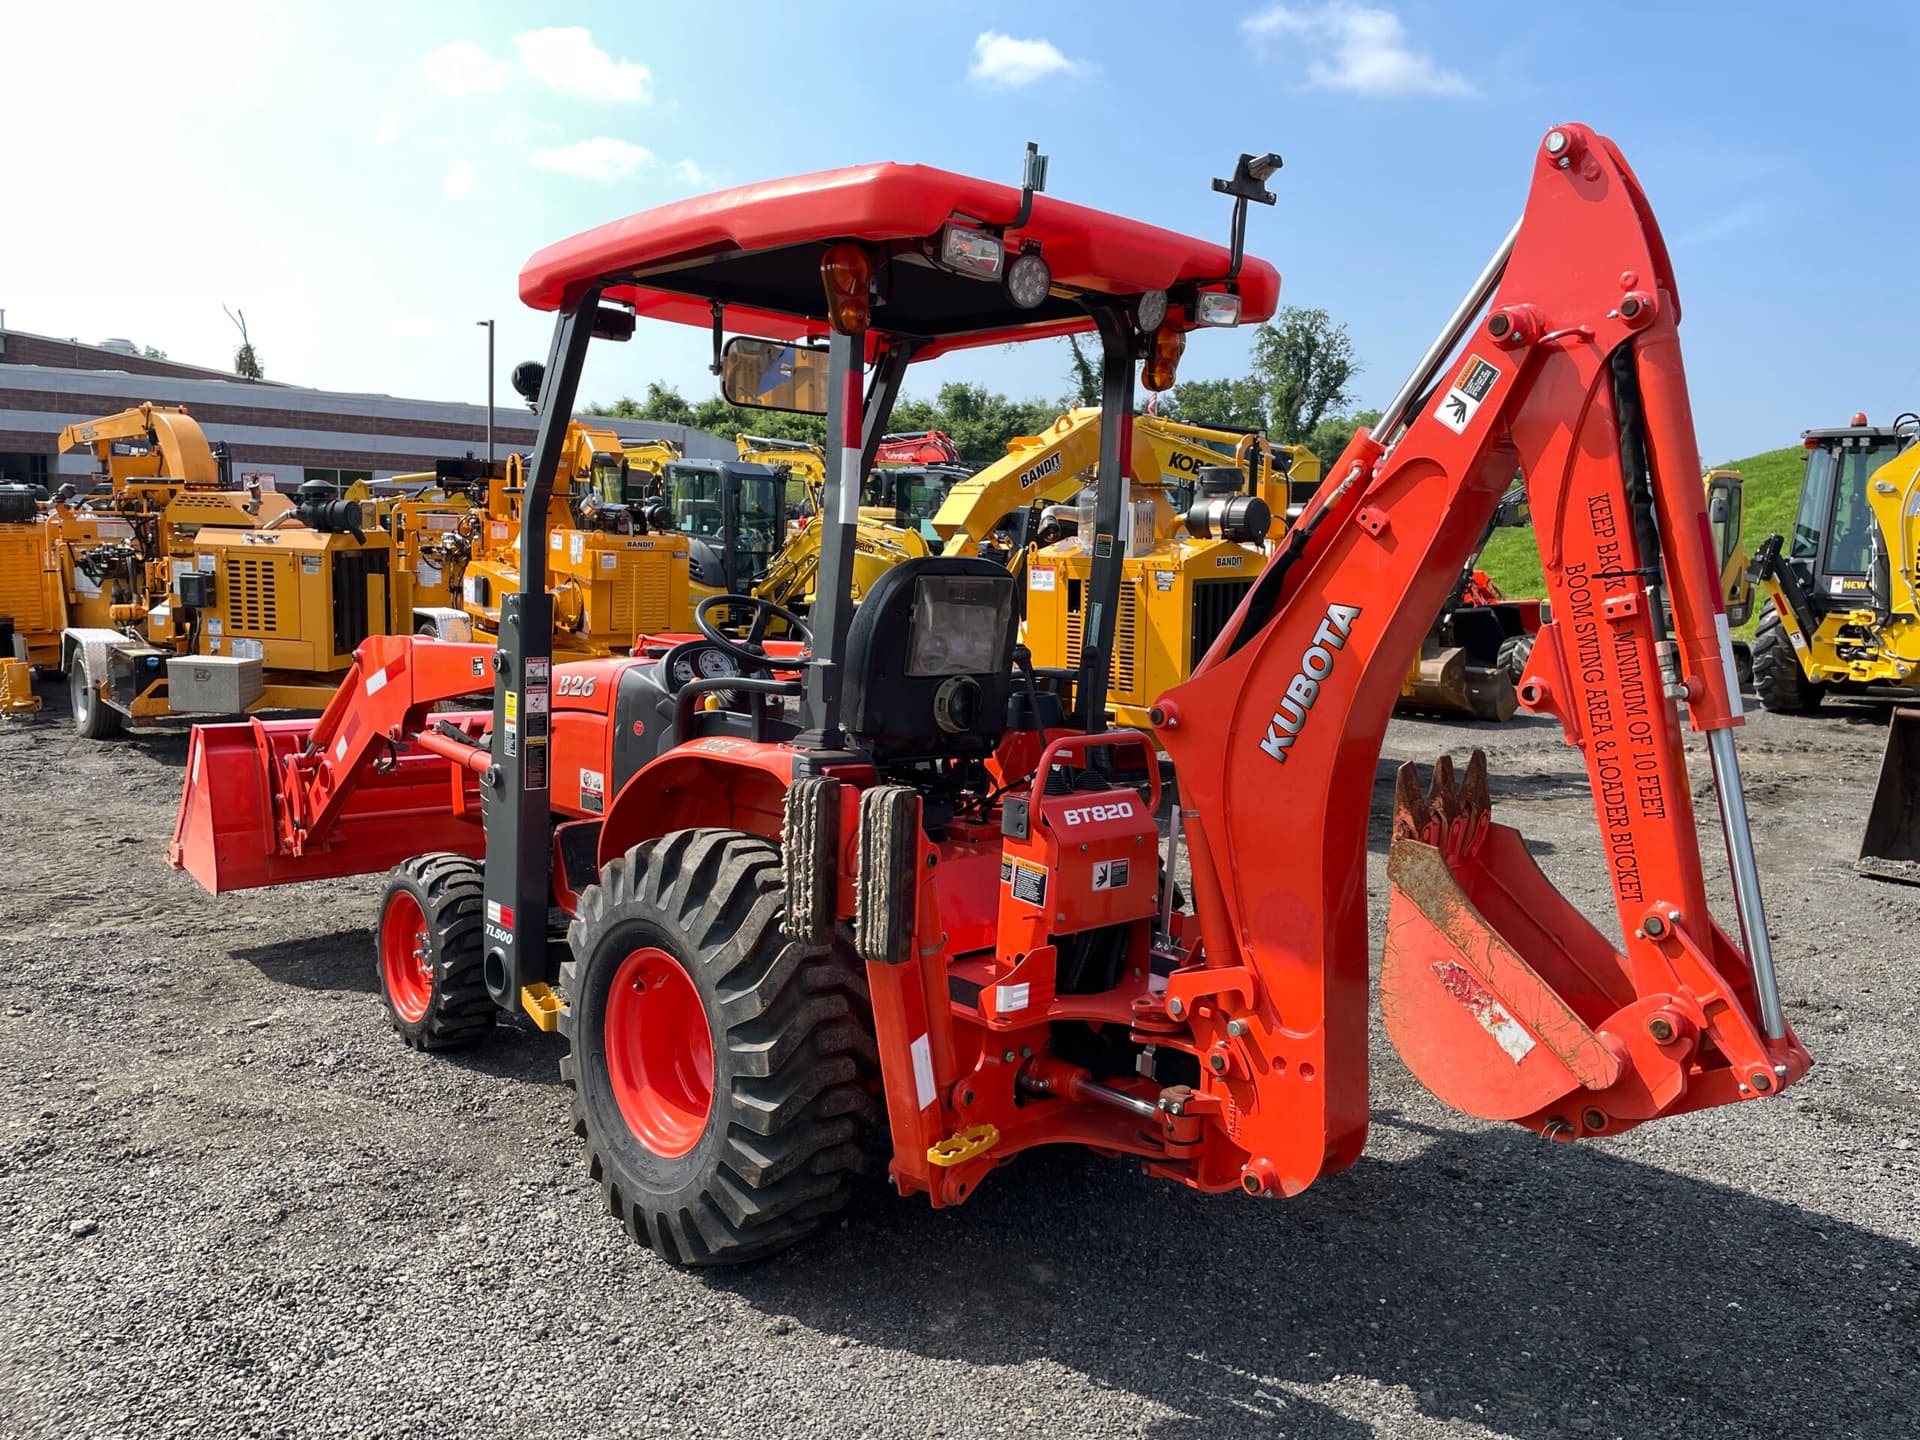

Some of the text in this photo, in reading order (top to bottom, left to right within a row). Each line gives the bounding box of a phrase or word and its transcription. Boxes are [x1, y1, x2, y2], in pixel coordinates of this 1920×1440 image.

[1020, 452, 1060, 489] BANDIT
[1588, 493, 1616, 538] KEEP
[1217, 557, 1242, 567] BANDIT
[1597, 541, 1626, 592] BACK
[1843, 581, 1867, 590] NEW
[556, 674, 597, 697] B26
[1259, 603, 1363, 763] KUBOTA
[1613, 629, 1648, 717] MINIMUM
[1565, 563, 1644, 903] BOOM SWING AREA & LOADER BUCKET
[1628, 721, 1653, 746] OF
[1633, 752, 1657, 770] 10
[1637, 774, 1666, 819] FEET
[1063, 802, 1134, 826] BT820
[486, 922, 513, 945] TL500
